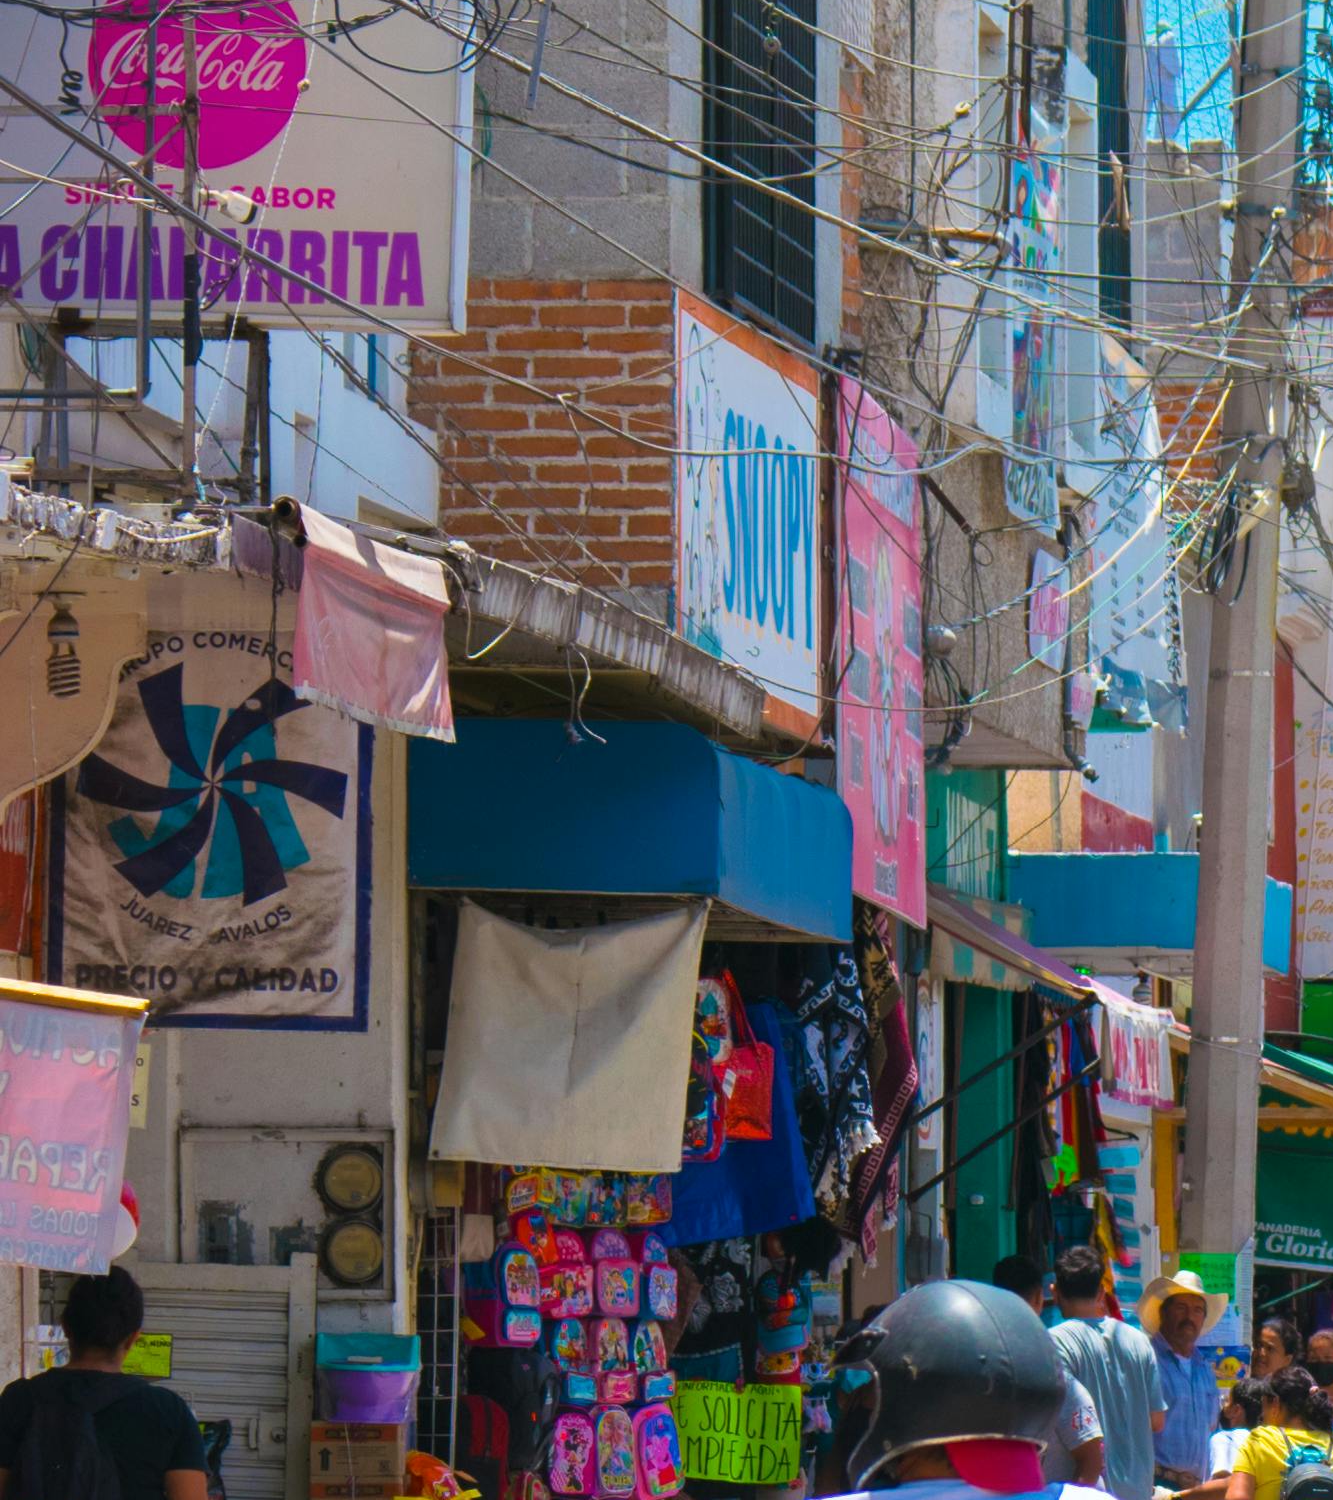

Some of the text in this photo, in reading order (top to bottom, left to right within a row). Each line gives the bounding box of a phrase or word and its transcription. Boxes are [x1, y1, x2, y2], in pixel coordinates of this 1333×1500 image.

[723, 407, 814, 650] SNOOPY
[120, 893, 193, 942] JUAREZ
[75, 962, 178, 992] PRECIO
[213, 966, 339, 994] CALIDAD
[699, 1395, 801, 1442] SOLICITA
